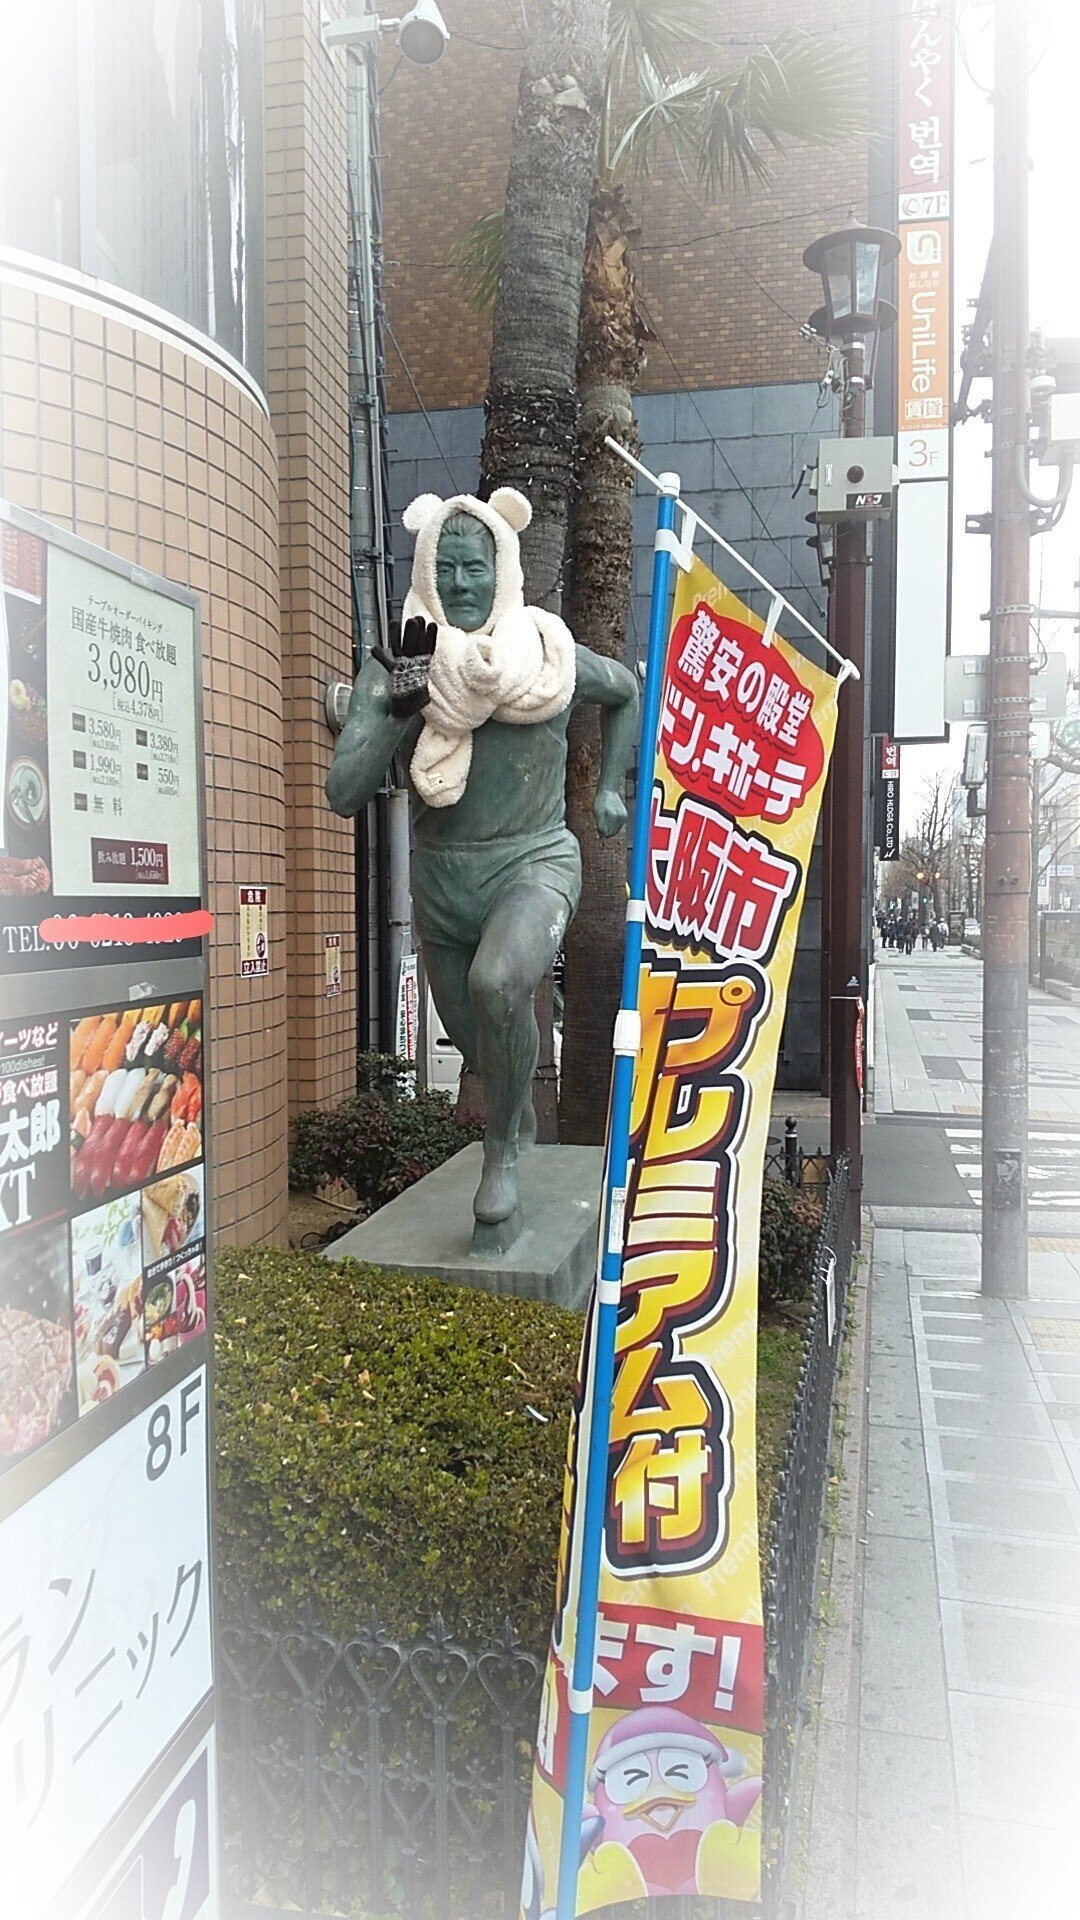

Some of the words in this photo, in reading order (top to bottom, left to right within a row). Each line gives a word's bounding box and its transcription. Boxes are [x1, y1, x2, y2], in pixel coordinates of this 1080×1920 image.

[907, 115, 943, 184] 번역
[922, 194, 948, 215] 7F
[911, 291, 937, 394] UniLife
[908, 439, 939, 467] 3F
[72, 606, 132, 650] 国産牛焼肉
[135, 632, 177, 666] 食べ放題
[88, 643, 163, 703] 3,980円
[677, 609, 812, 748] 驚安の殿堂
[130, 846, 164, 868] 1,500円
[242, 960, 267, 975] 立入禁止
[0, 1070, 58, 1106] 食べ放題
[147, 1373, 202, 1481] 8F
